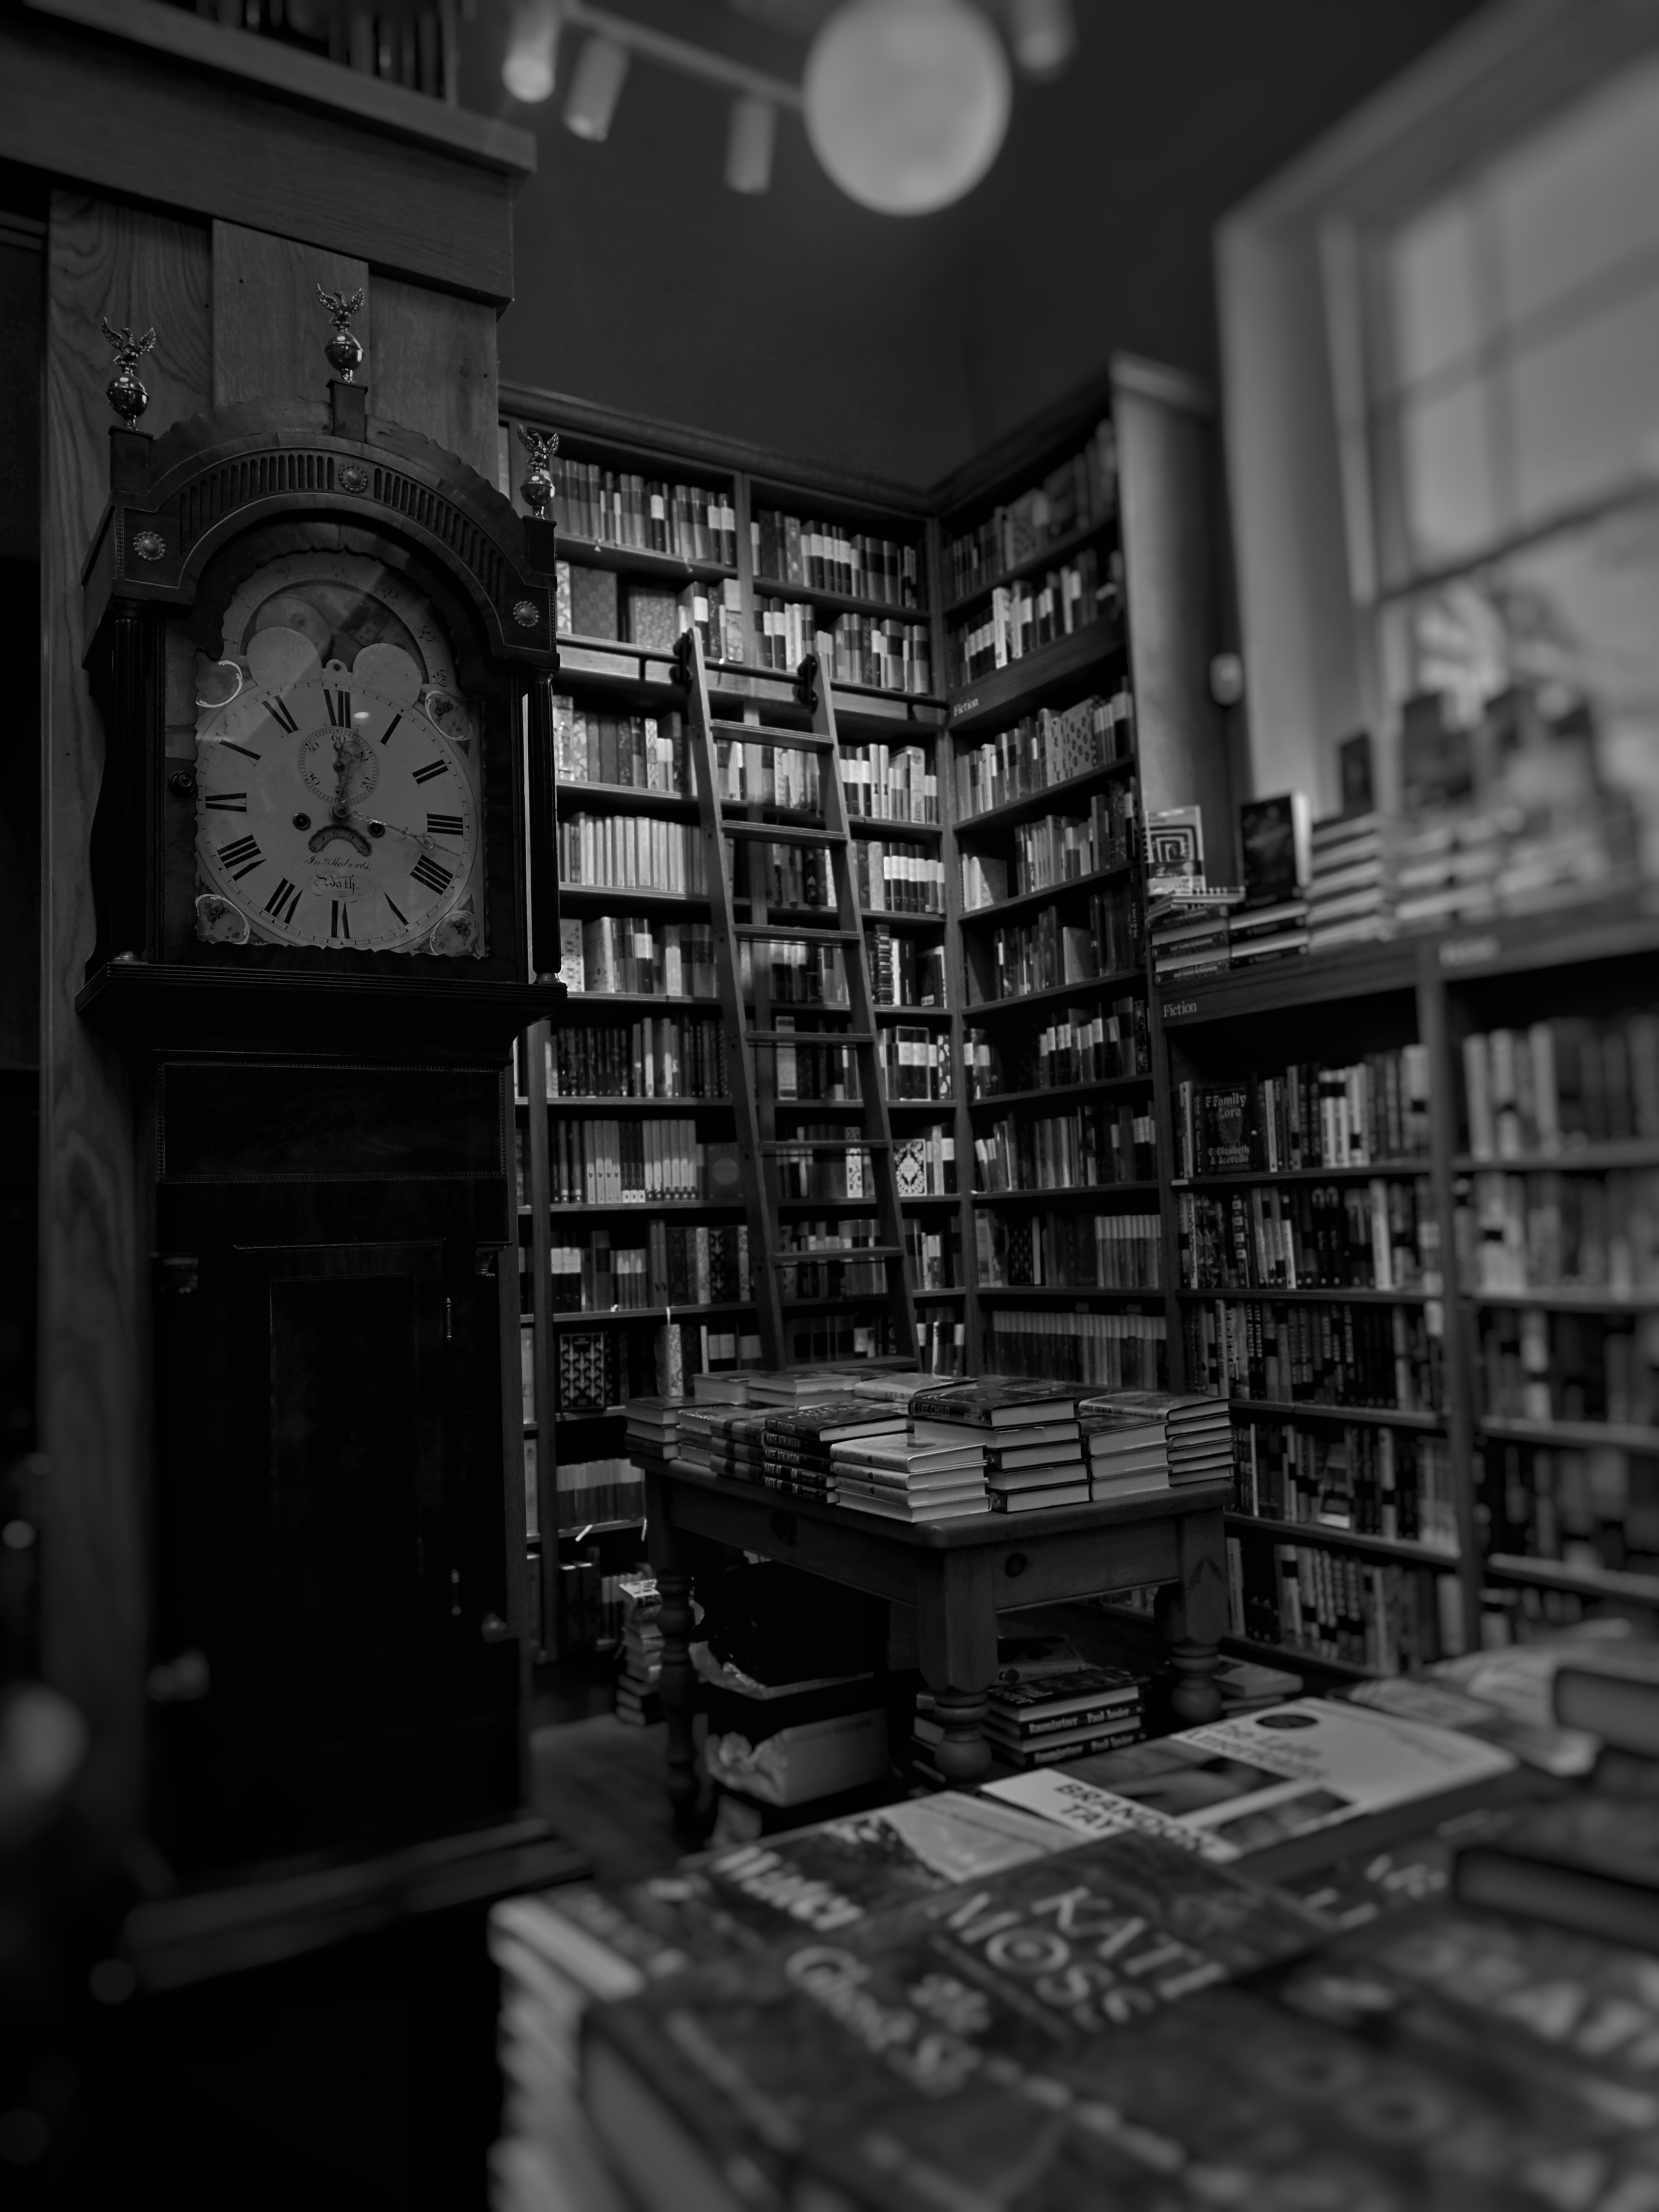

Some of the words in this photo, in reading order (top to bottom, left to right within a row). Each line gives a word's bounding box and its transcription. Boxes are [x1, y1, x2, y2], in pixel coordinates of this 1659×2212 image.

[322, 688, 351, 728] XII
[953, 699, 978, 717] Fiction
[308, 742, 320, 754] 50
[331, 734, 346, 742] 60
[411, 758, 448, 785] II
[426, 812, 464, 835] III
[217, 834, 267, 882] VIII
[408, 853, 454, 896] IIII
[264, 877, 303, 925] VII
[331, 899, 350, 939] VI
[1163, 1000, 1197, 1018] Fiction
[1213, 1092, 1246, 1107] Family
[930, 1404, 950, 1416] CHILD
[1087, 1711, 1105, 1725] Paul
